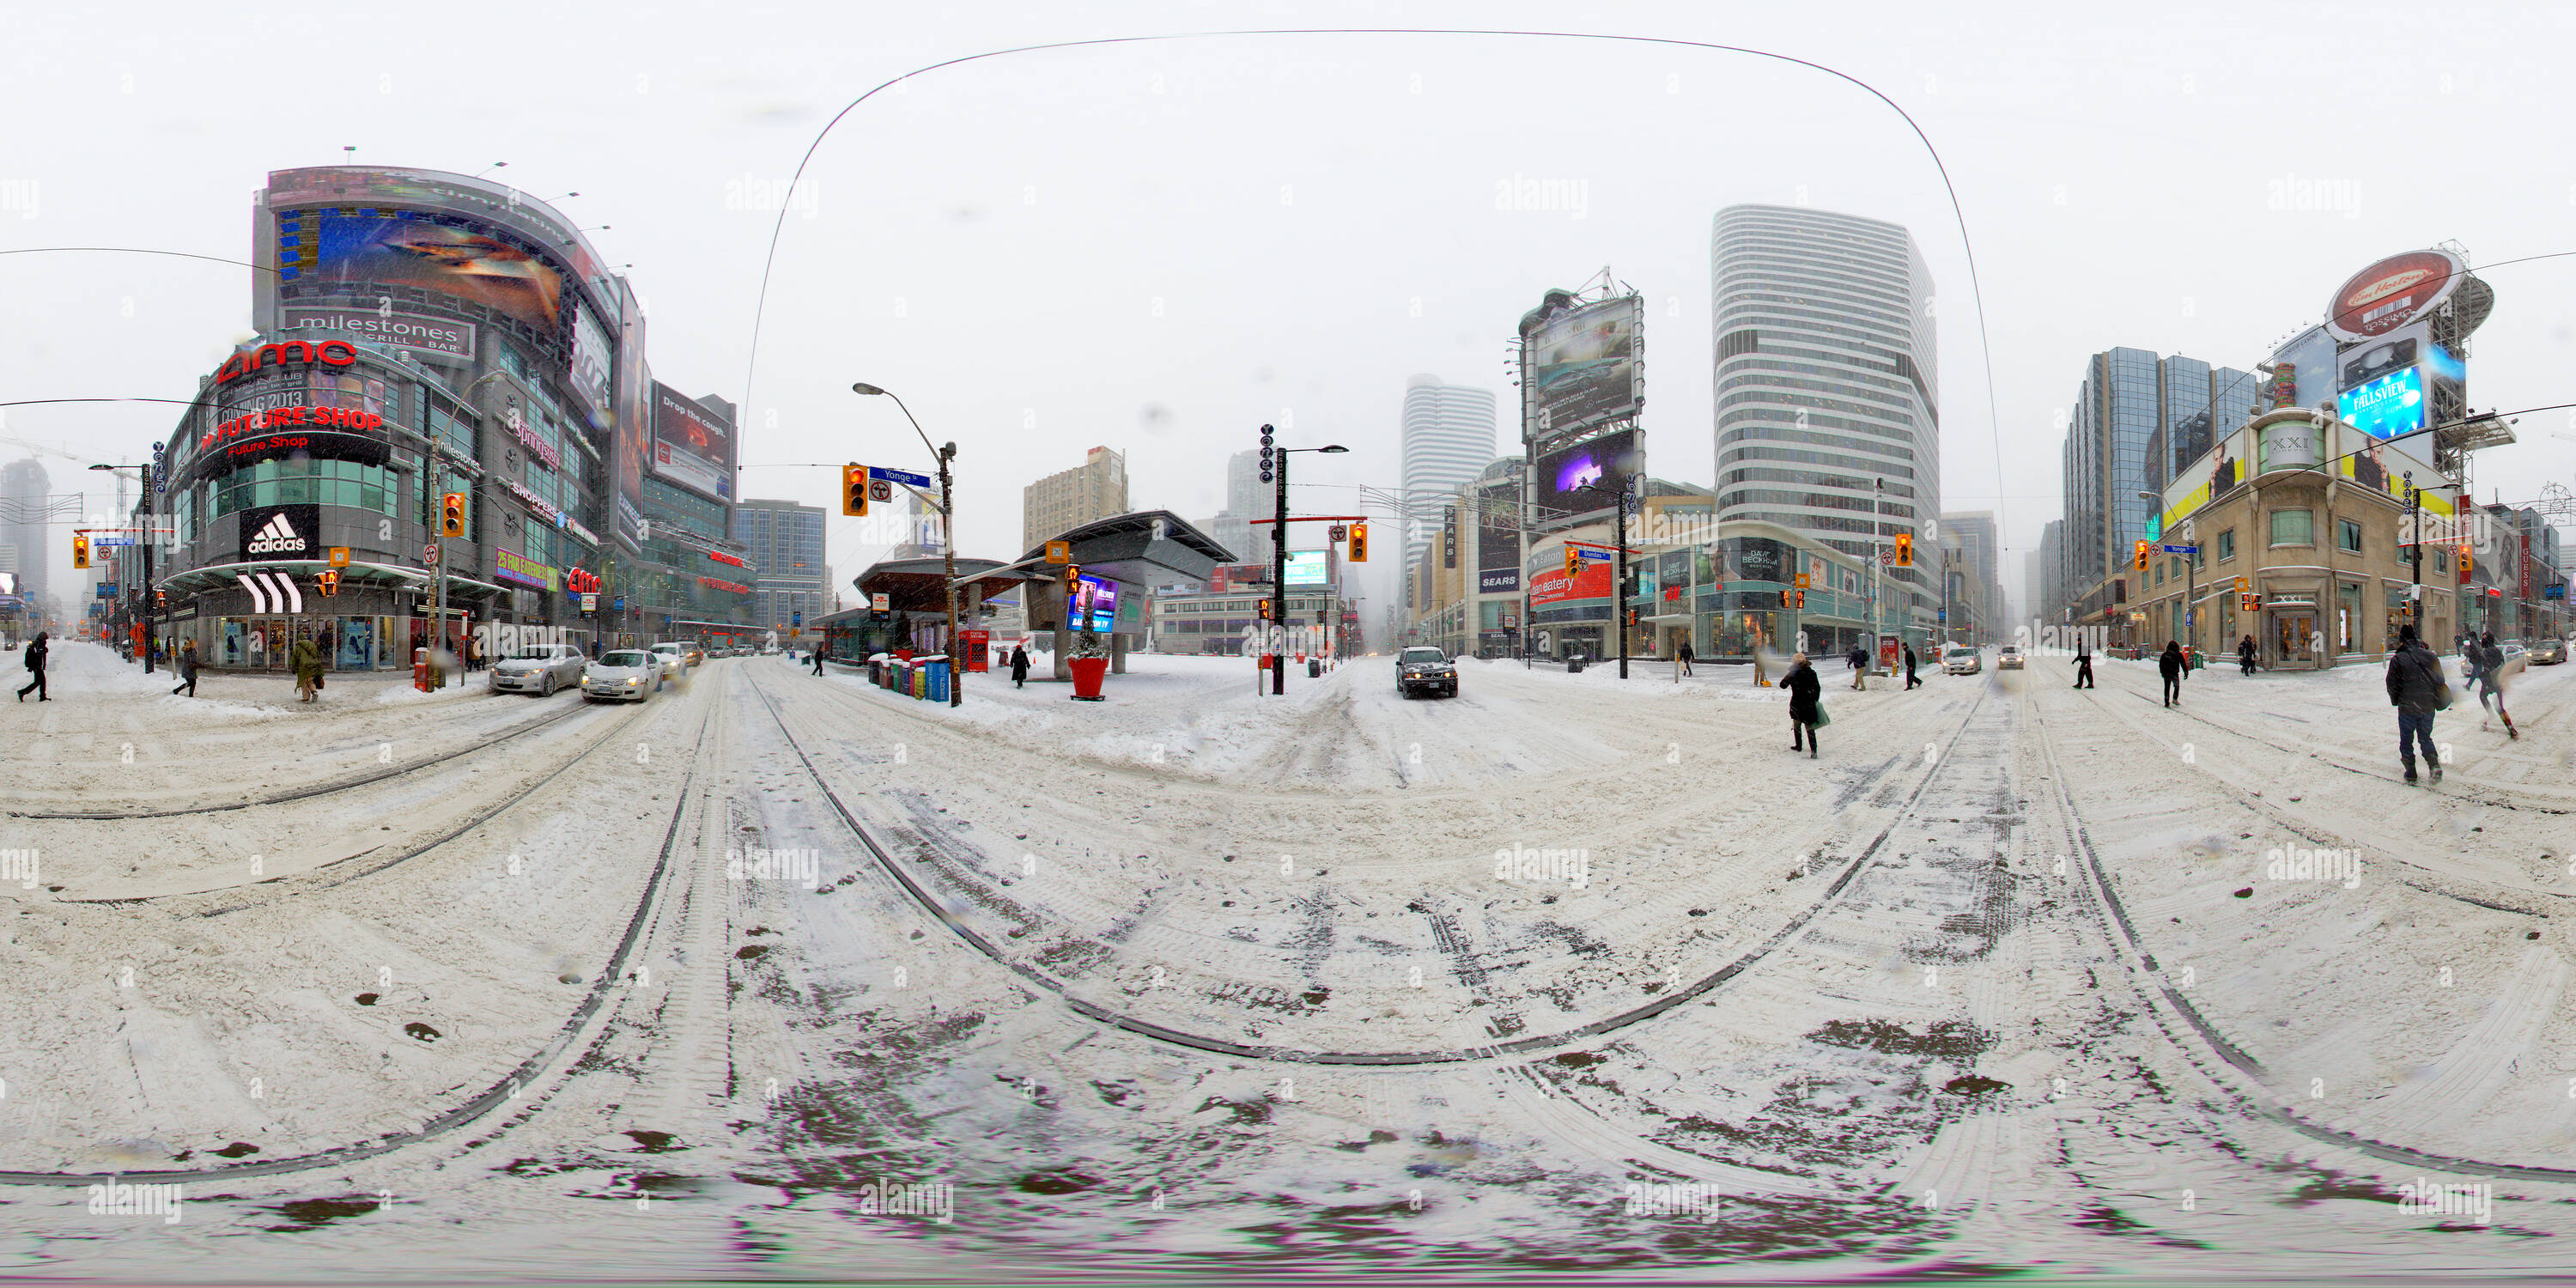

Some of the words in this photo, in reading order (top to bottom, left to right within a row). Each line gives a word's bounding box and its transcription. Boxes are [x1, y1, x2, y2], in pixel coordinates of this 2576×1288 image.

[300, 315, 458, 342] milestones
[2364, 308, 2412, 331] TOSSIMO
[428, 341, 458, 352] BAR
[222, 396, 265, 423] COMING
[269, 392, 303, 409] 2013
[663, 396, 686, 415] Drop
[687, 409, 701, 422] the
[702, 419, 726, 438] cough.
[217, 406, 307, 442] FUTURE
[314, 406, 384, 431] SHOP
[228, 440, 266, 458] Future
[270, 436, 308, 448] Shop
[2274, 437, 2308, 450] XXI
[884, 470, 911, 483] Yonge
[511, 481, 556, 517] SHOPPERS
[248, 538, 306, 554] adidas
[498, 550, 507, 568] 25
[507, 554, 519, 573] FAB
[520, 559, 547, 580] EATERIES!
[1072, 582, 1078, 592] 4
[1483, 576, 1516, 587] SEARS
[1543, 577, 1575, 592] eatery
